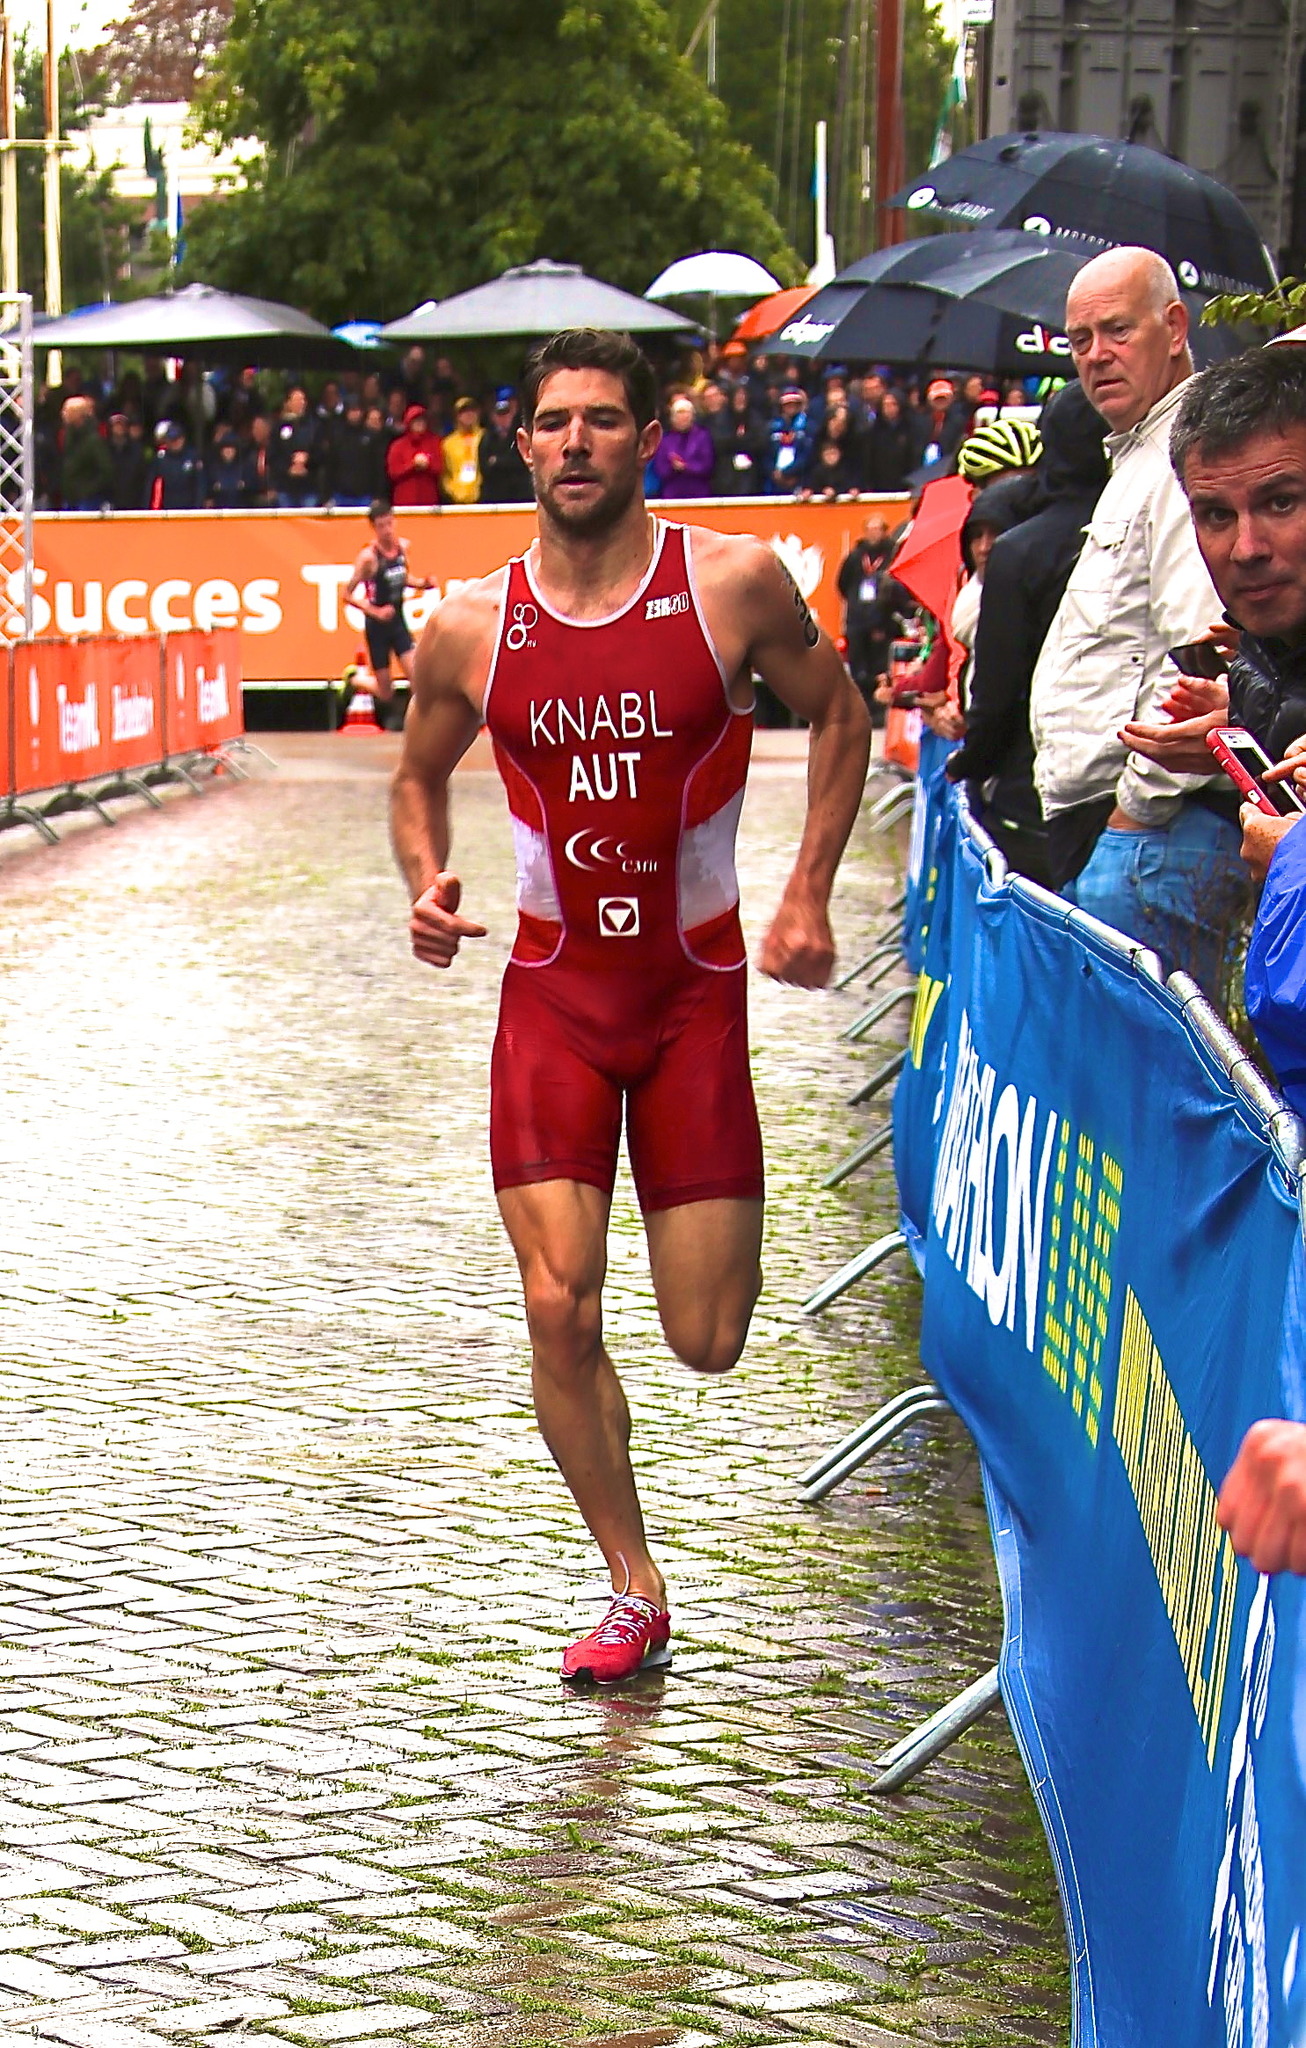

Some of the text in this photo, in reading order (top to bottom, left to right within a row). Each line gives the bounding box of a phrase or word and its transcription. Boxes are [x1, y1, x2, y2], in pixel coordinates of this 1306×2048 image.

[6, 565, 283, 635] Succes
[529, 689, 673, 747] KNABL
[568, 752, 641, 803] AUT
